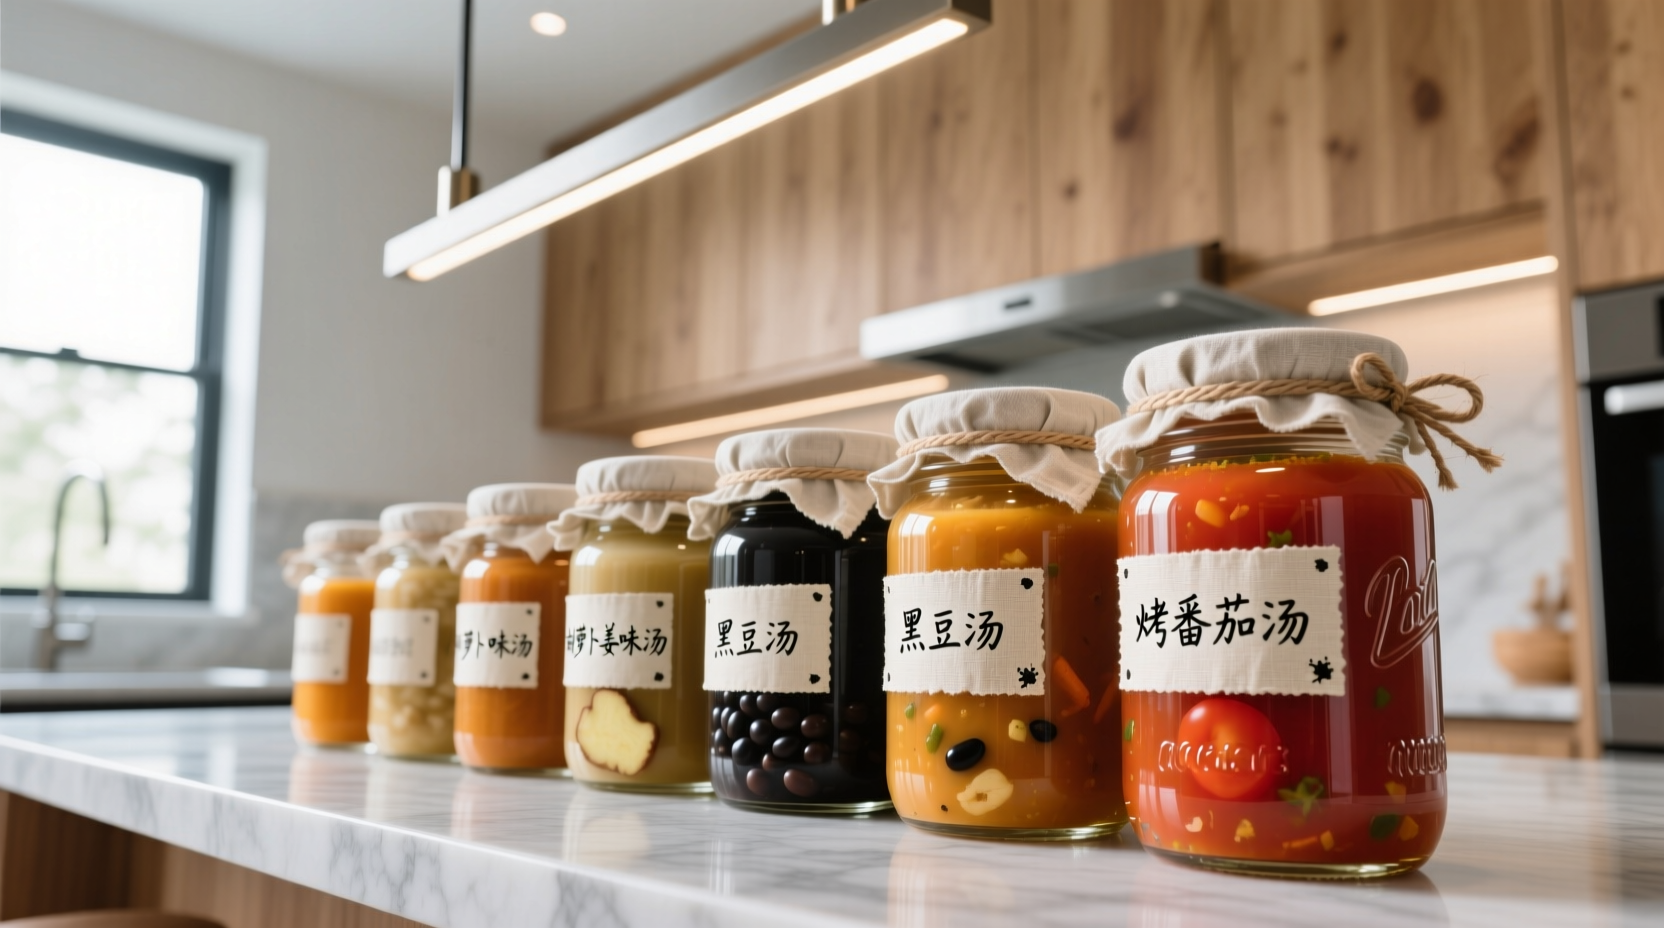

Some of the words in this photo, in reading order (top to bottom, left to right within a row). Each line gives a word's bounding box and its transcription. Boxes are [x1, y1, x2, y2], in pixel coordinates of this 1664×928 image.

[714, 619, 799, 658] 黑豆汤
[900, 607, 1004, 654] 黑豆汤
[1135, 592, 1310, 649] 烤番茄汤
